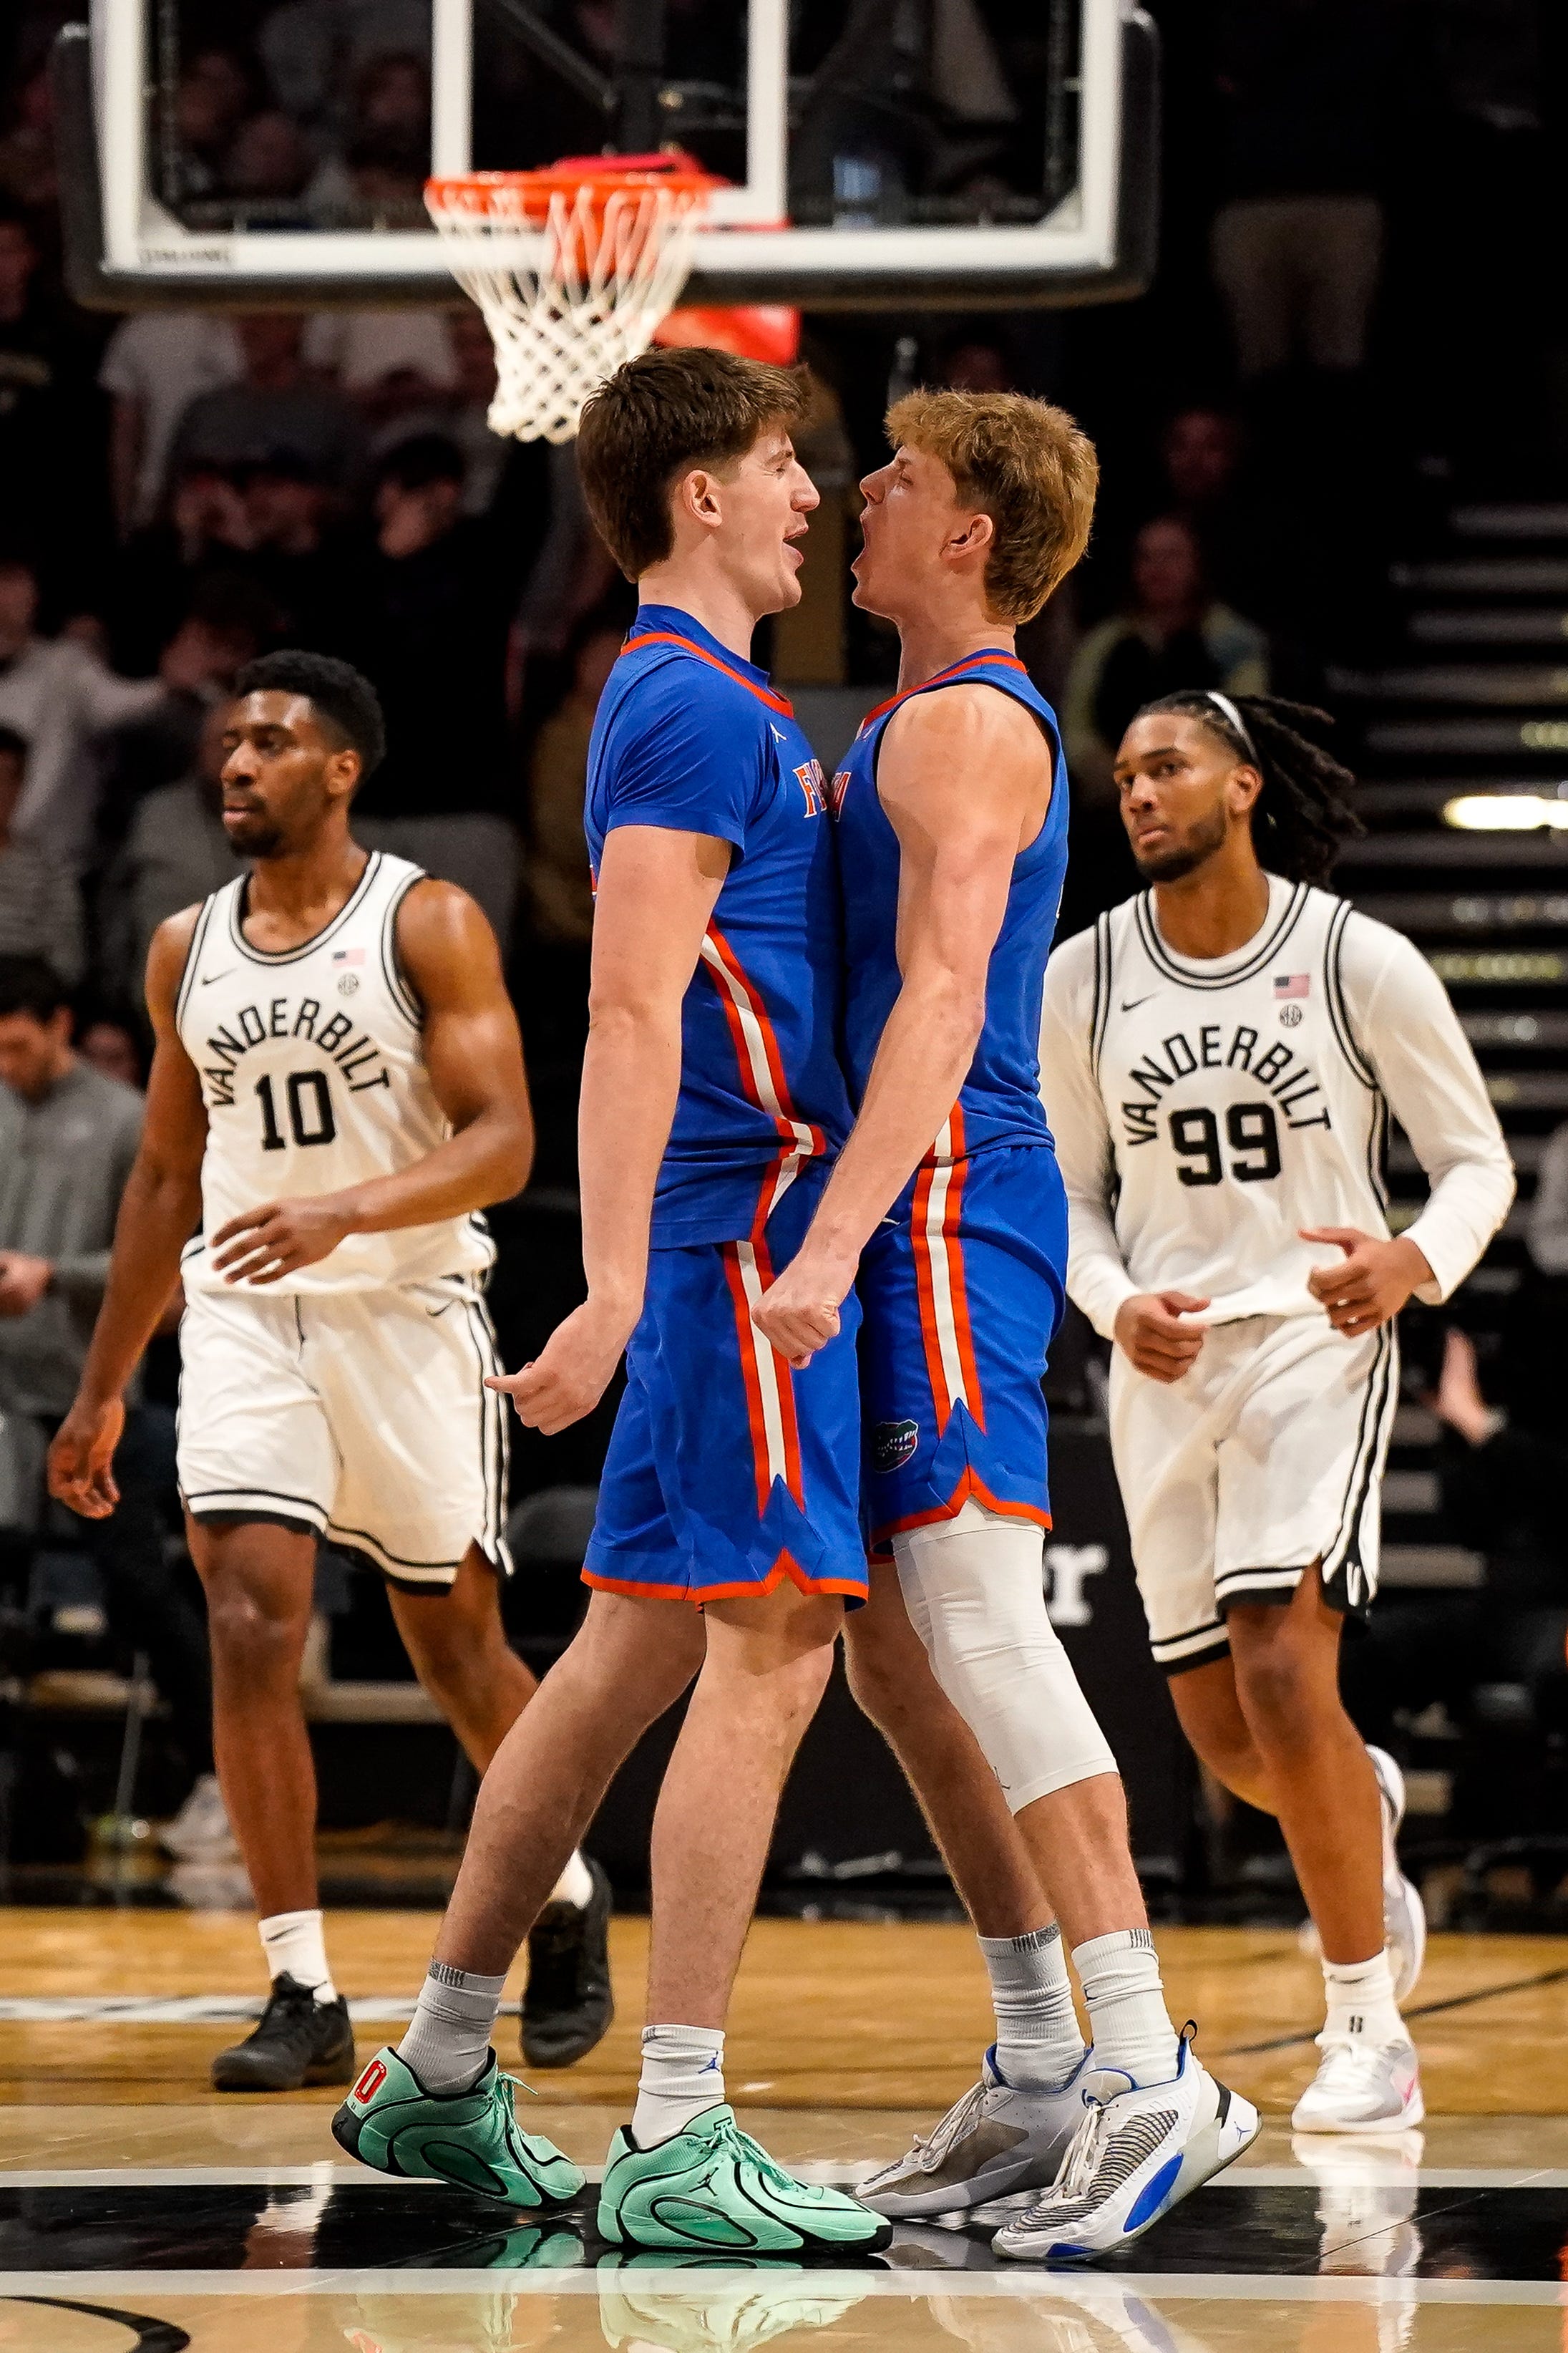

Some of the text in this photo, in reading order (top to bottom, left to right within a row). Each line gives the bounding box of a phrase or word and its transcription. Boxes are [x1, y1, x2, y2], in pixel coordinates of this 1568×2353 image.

[203, 998, 390, 1106] VANDERBILT
[1121, 1025, 1332, 1146] VANDERBILT
[255, 1069, 336, 1150] 10
[1169, 1102, 1282, 1185] 99
[1043, 1543, 1109, 1626] r
